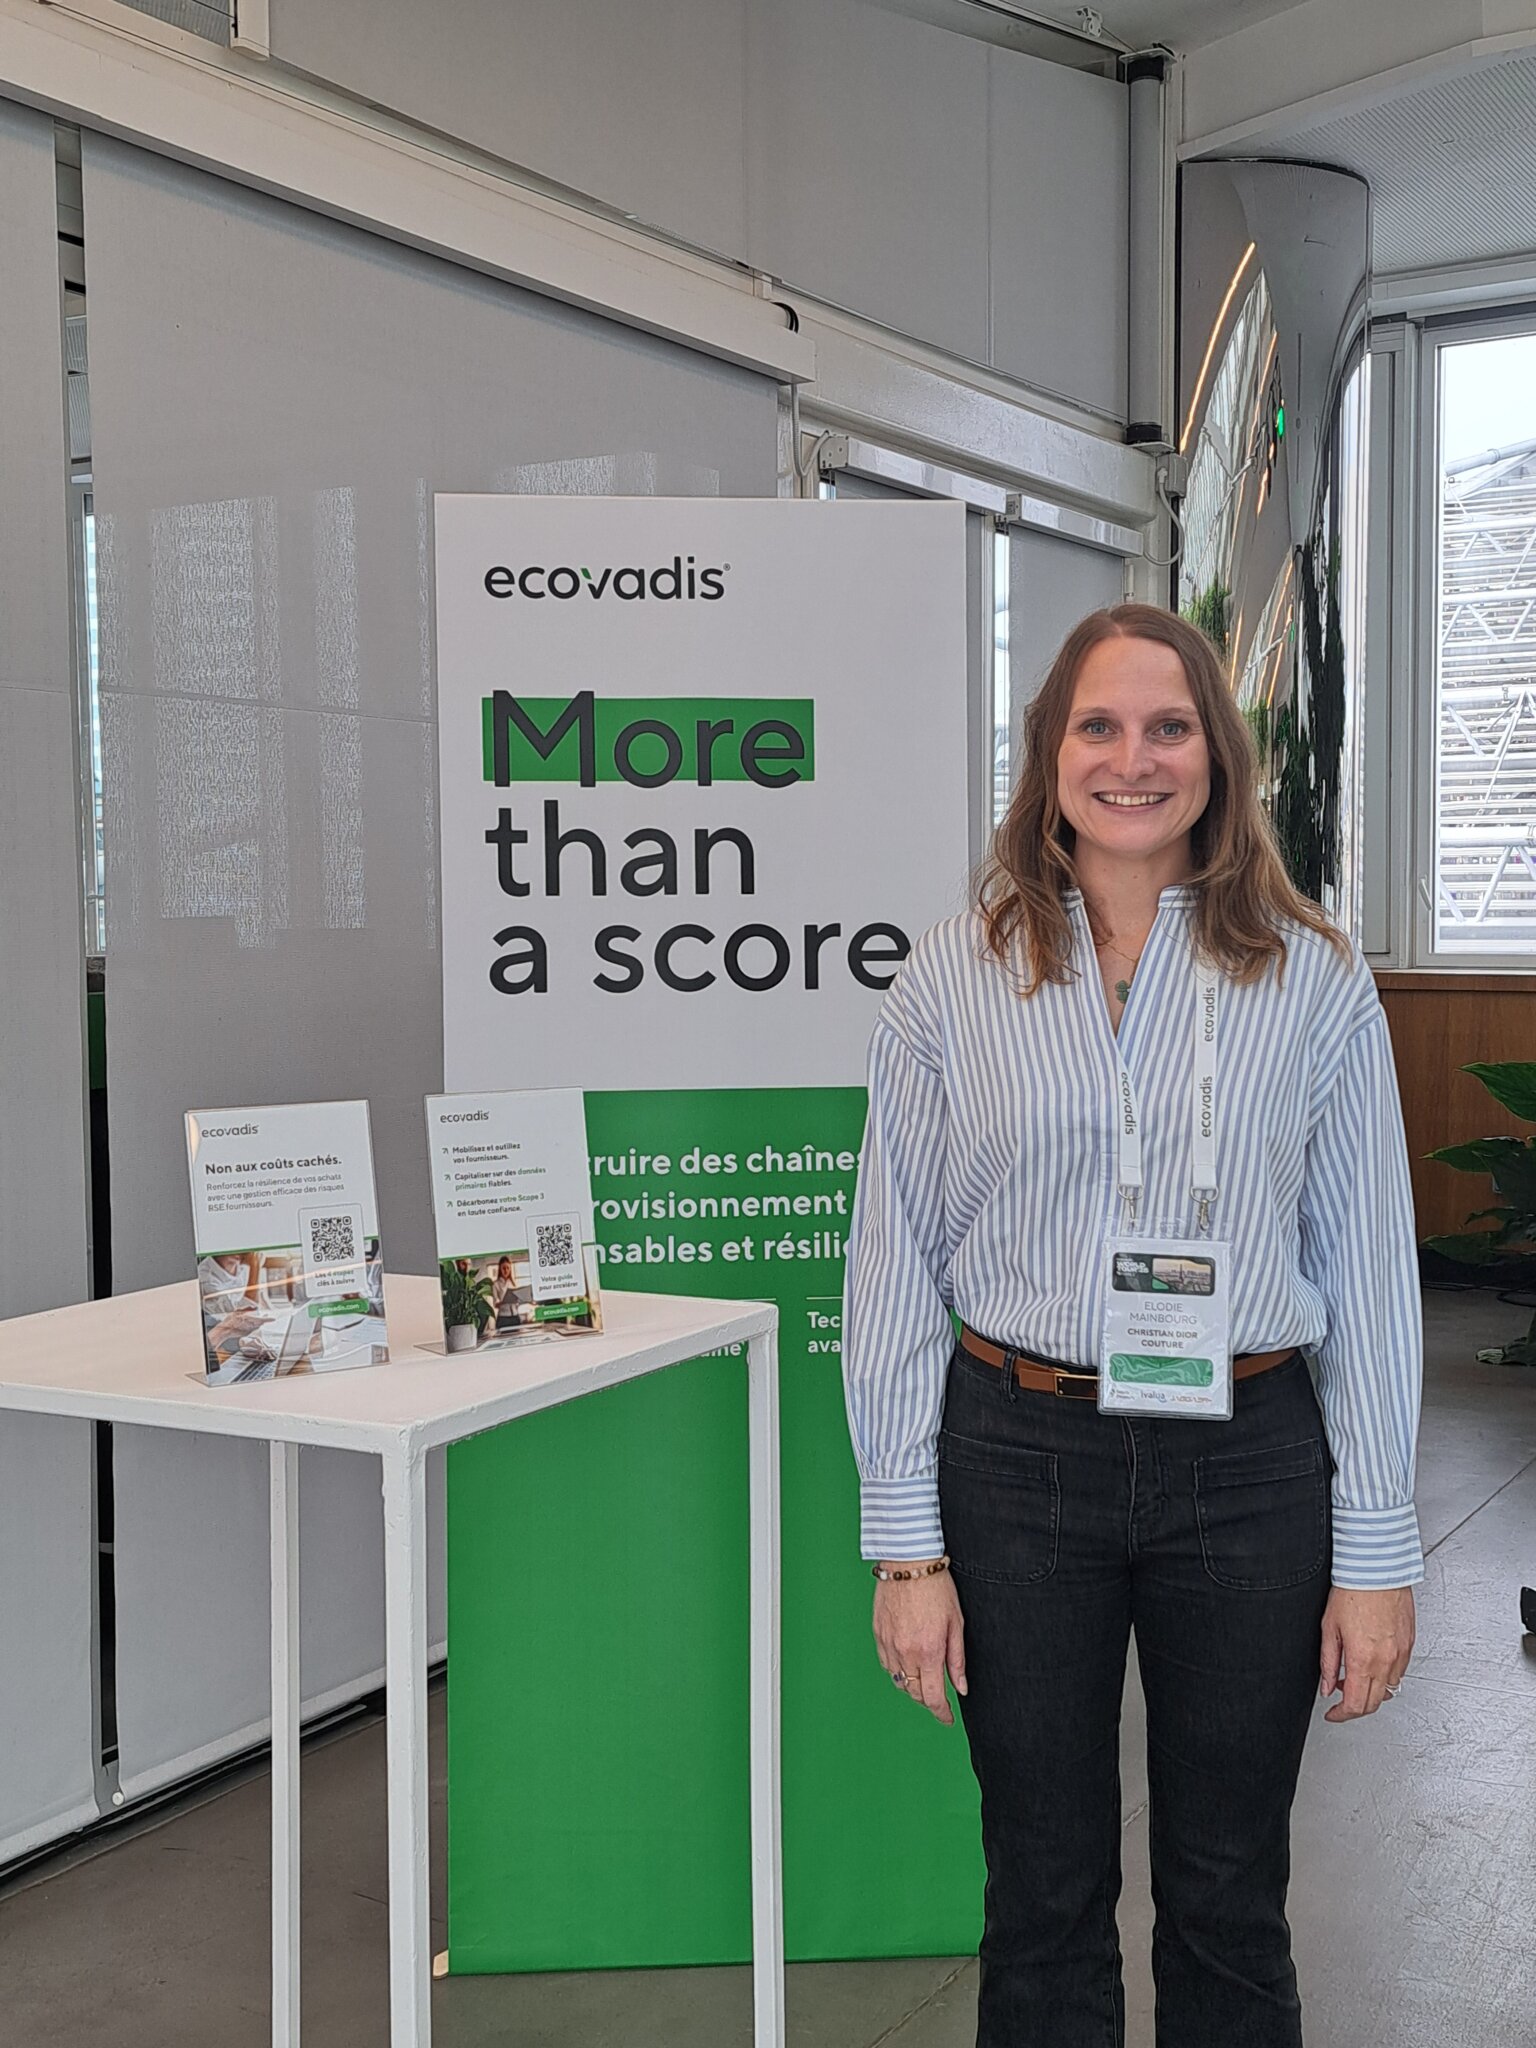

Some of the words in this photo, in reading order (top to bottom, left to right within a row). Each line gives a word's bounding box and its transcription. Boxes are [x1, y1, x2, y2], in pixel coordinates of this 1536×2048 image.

[484, 556, 725, 600] ecovadis
[492, 690, 805, 788] More
[485, 800, 755, 897] than
[489, 926, 548, 995] a
[593, 922, 911, 994] score
[1203, 986, 1216, 1042] ecovadis
[1121, 1071, 1136, 1135] ecovadis
[1199, 1076, 1213, 1138] ecovadis
[440, 1110, 489, 1123] ecovadis
[201, 1123, 259, 1138] ecovadis
[205, 1163, 232, 1175] Non
[235, 1163, 257, 1173] aux
[260, 1158, 294, 1171] coûts
[296, 1154, 342, 1168] cachés.
[588, 1147, 672, 1176] ruire
[680, 1147, 738, 1175] des
[206, 1182, 246, 1191] Renforcez
[317, 1173, 342, 1182] achats
[454, 1170, 492, 1181] Capitaliser
[504, 1168, 517, 1177] des
[207, 1194, 225, 1202] avec
[303, 1185, 317, 1193] des
[208, 1203, 223, 1212] RSE
[721, 1236, 755, 1262] et
[1144, 1301, 1184, 1312] ELODIE
[1128, 1312, 1198, 1325] MAINBOURG
[1127, 1328, 1174, 1338] CHRISTIAN
[1175, 1330, 1198, 1339] DIOR
[1141, 1339, 1184, 1349] COUTURE
